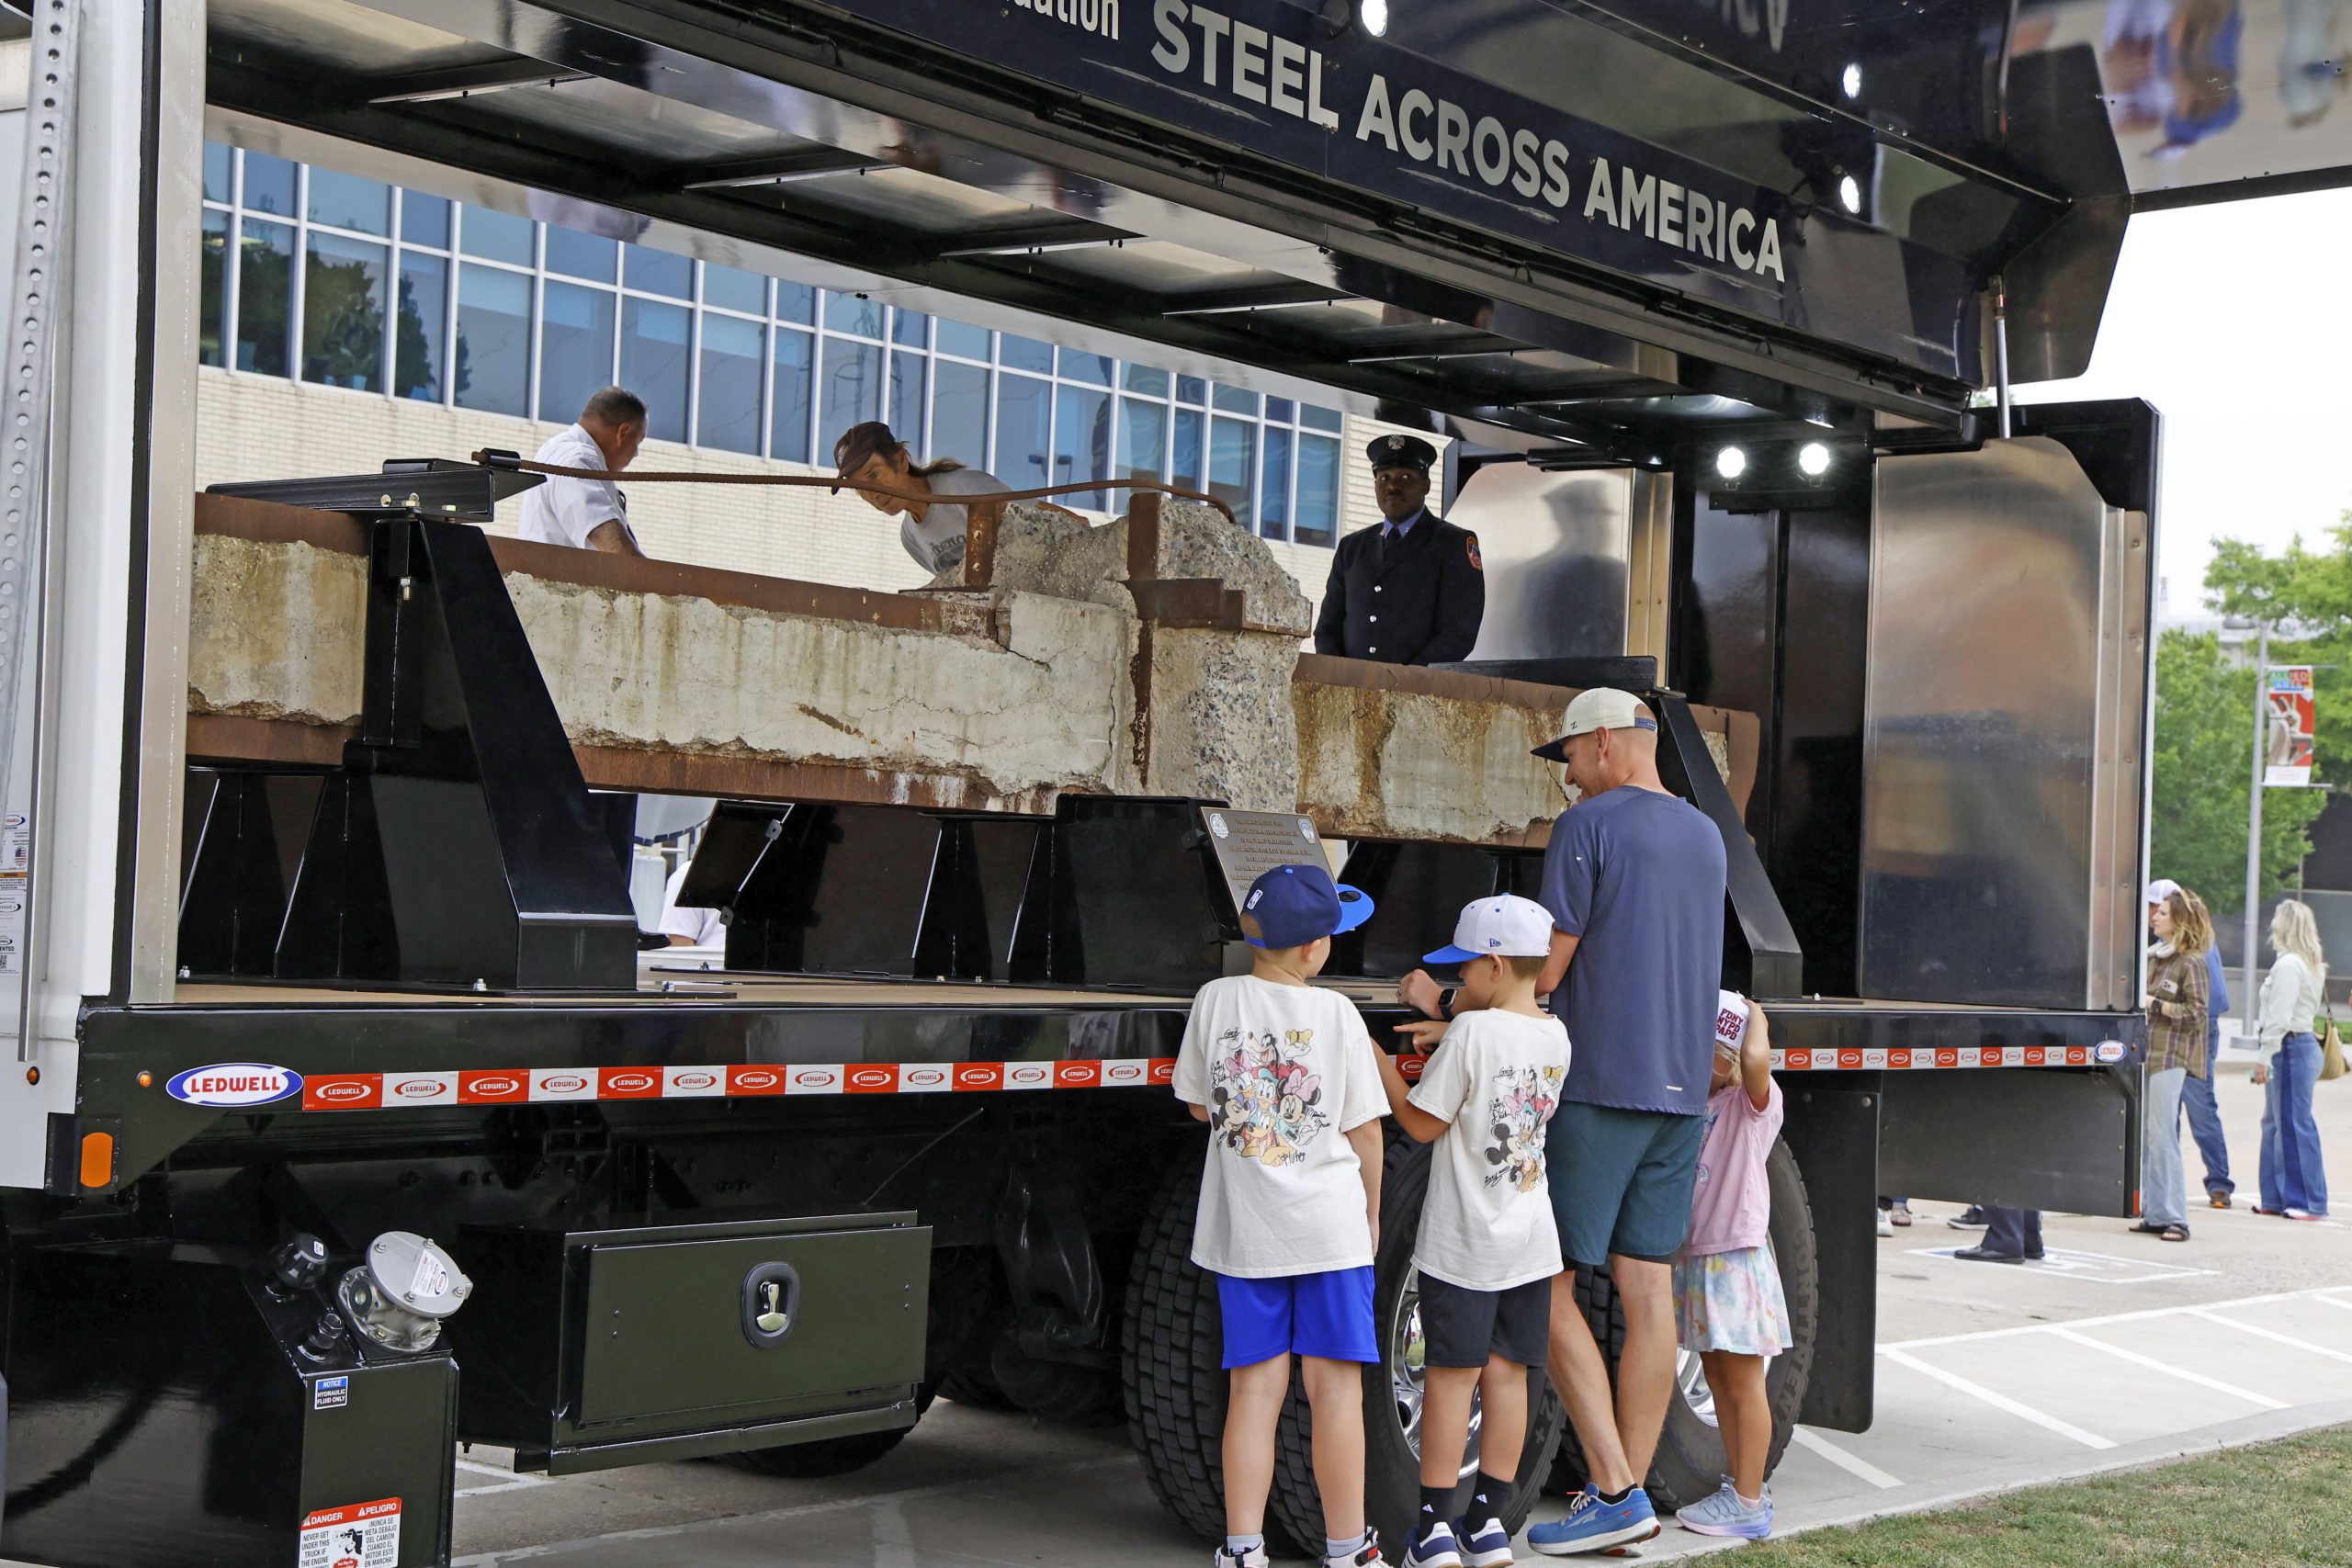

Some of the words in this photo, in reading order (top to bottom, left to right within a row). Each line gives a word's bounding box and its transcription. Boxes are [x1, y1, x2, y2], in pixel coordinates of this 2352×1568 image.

[1150, 0, 1339, 133] STEEL
[1355, 73, 1570, 208] ACROSS
[1583, 155, 1785, 283] AMERICA
[1717, 1015, 1741, 1033] NYPD
[190, 1076, 281, 1094] LEDWELL
[480, 1082, 509, 1090] LEDWELL
[322, 1379, 342, 1388] NOTICE
[317, 1389, 346, 1397] HYDRAULIC
[366, 1502, 397, 1516] PELIGRO
[311, 1512, 343, 1525] DANGER
[302, 1532, 320, 1541] NEVER
[320, 1530, 330, 1539] GET
[365, 1528, 378, 1536] META
[379, 1525, 397, 1534] DEBAJO
[301, 1542, 319, 1551] UNDER
[319, 1540, 330, 1549] THIS
[366, 1536, 376, 1544] DEL
[367, 1541, 387, 1551] CUANDO
[304, 1551, 321, 1559] TRUCK
[365, 1551, 381, 1559] MOTOR
[301, 1559, 311, 1567] THE
[311, 1556, 329, 1565] ENGINE
[372, 1556, 394, 1566] MARCHA!
